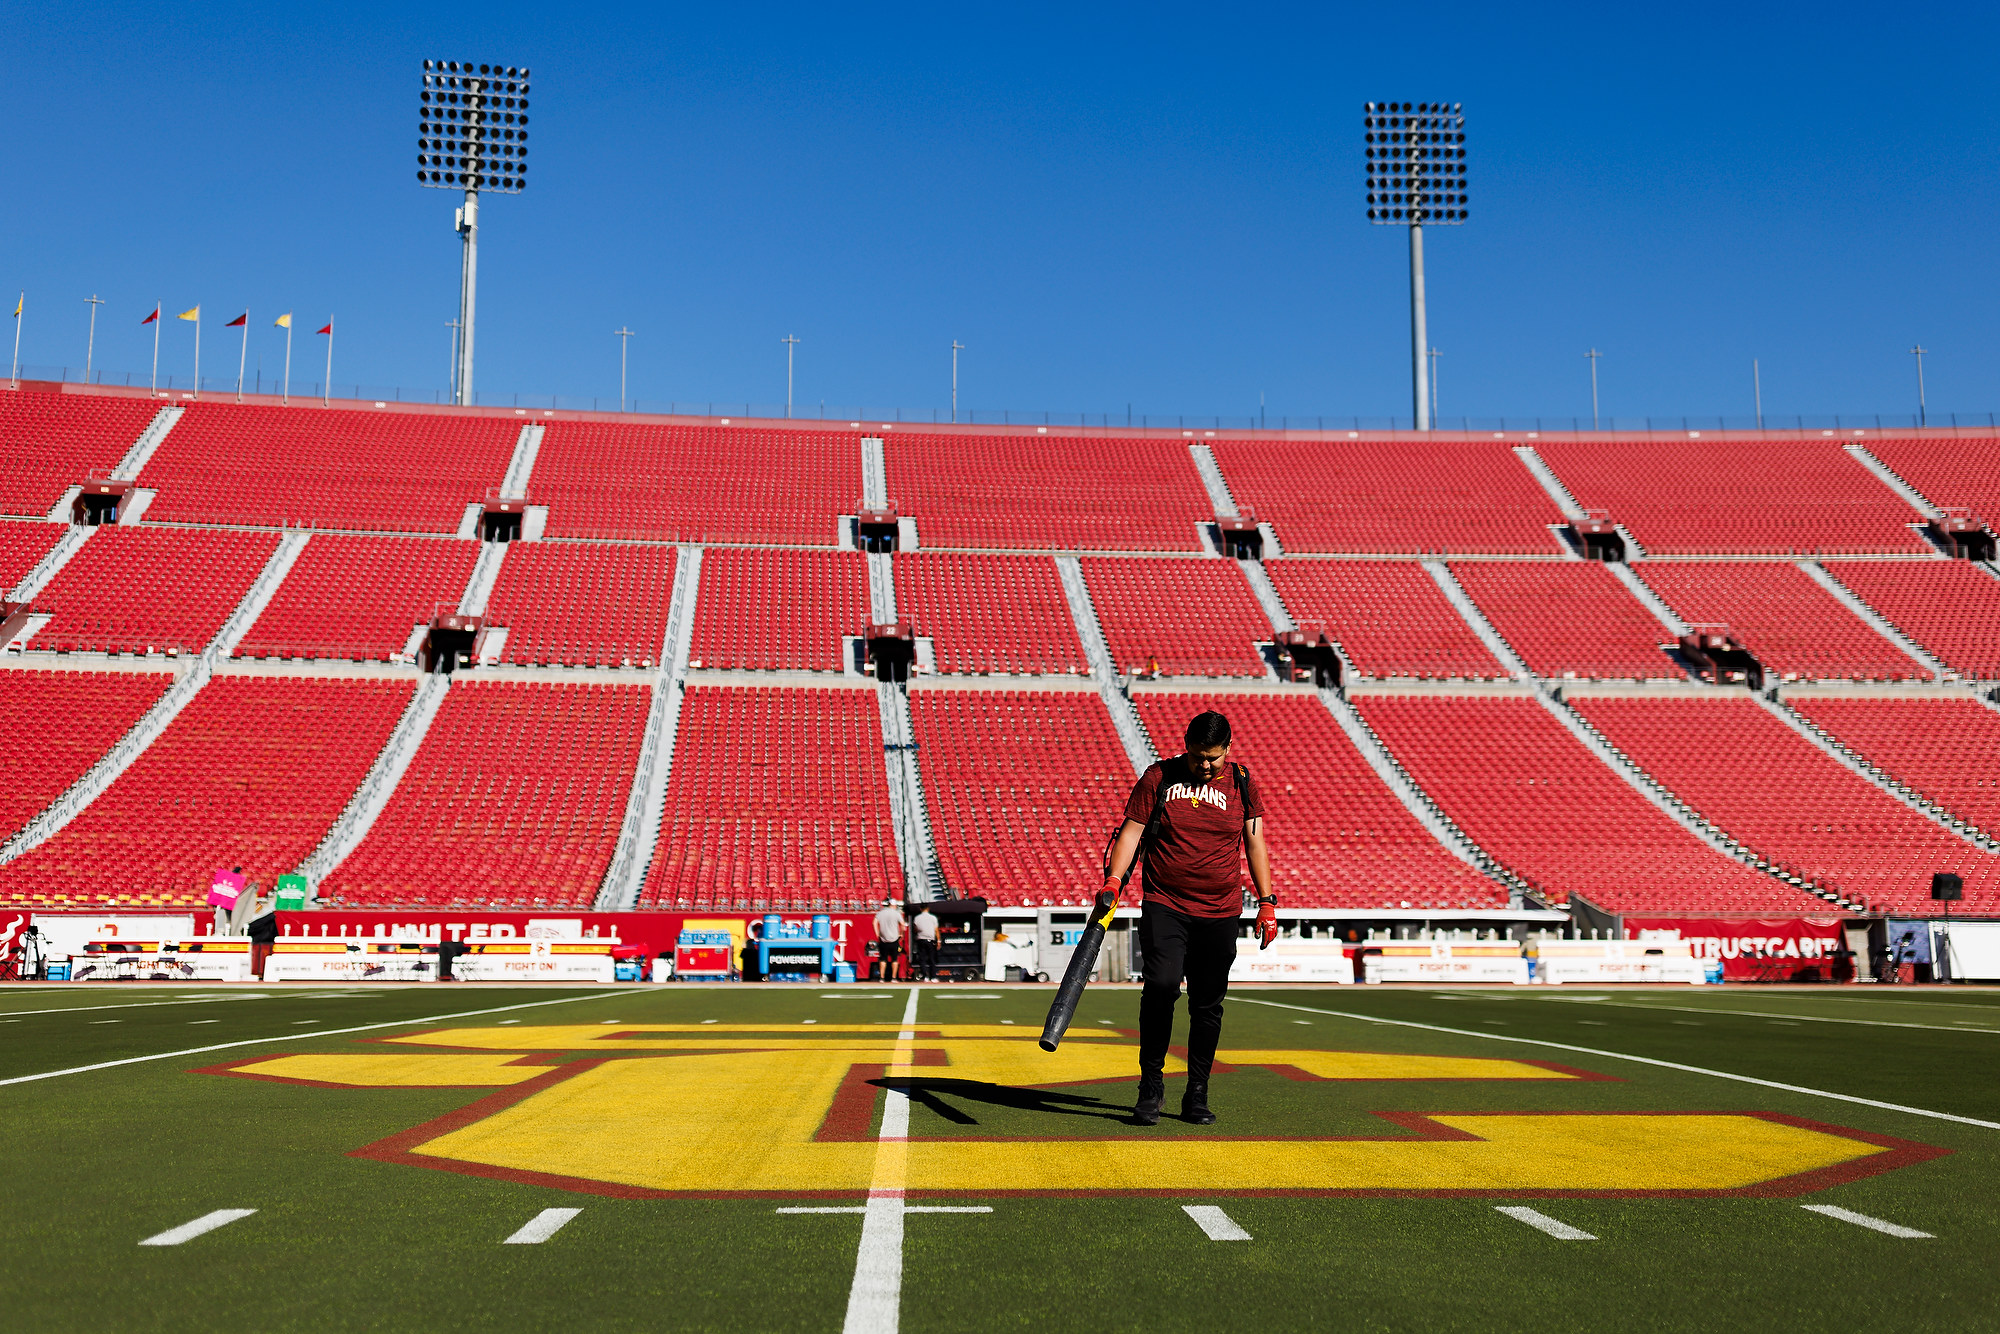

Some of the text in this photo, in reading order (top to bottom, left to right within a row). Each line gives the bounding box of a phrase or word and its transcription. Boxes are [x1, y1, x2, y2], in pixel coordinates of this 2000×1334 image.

[1165, 783, 1227, 811] TROJANS
[1684, 936, 1839, 959] TRUSTCAPIT
[504, 962, 536, 971] FIGHT
[539, 962, 557, 971] ON!
[769, 955, 820, 964] POWERADE
